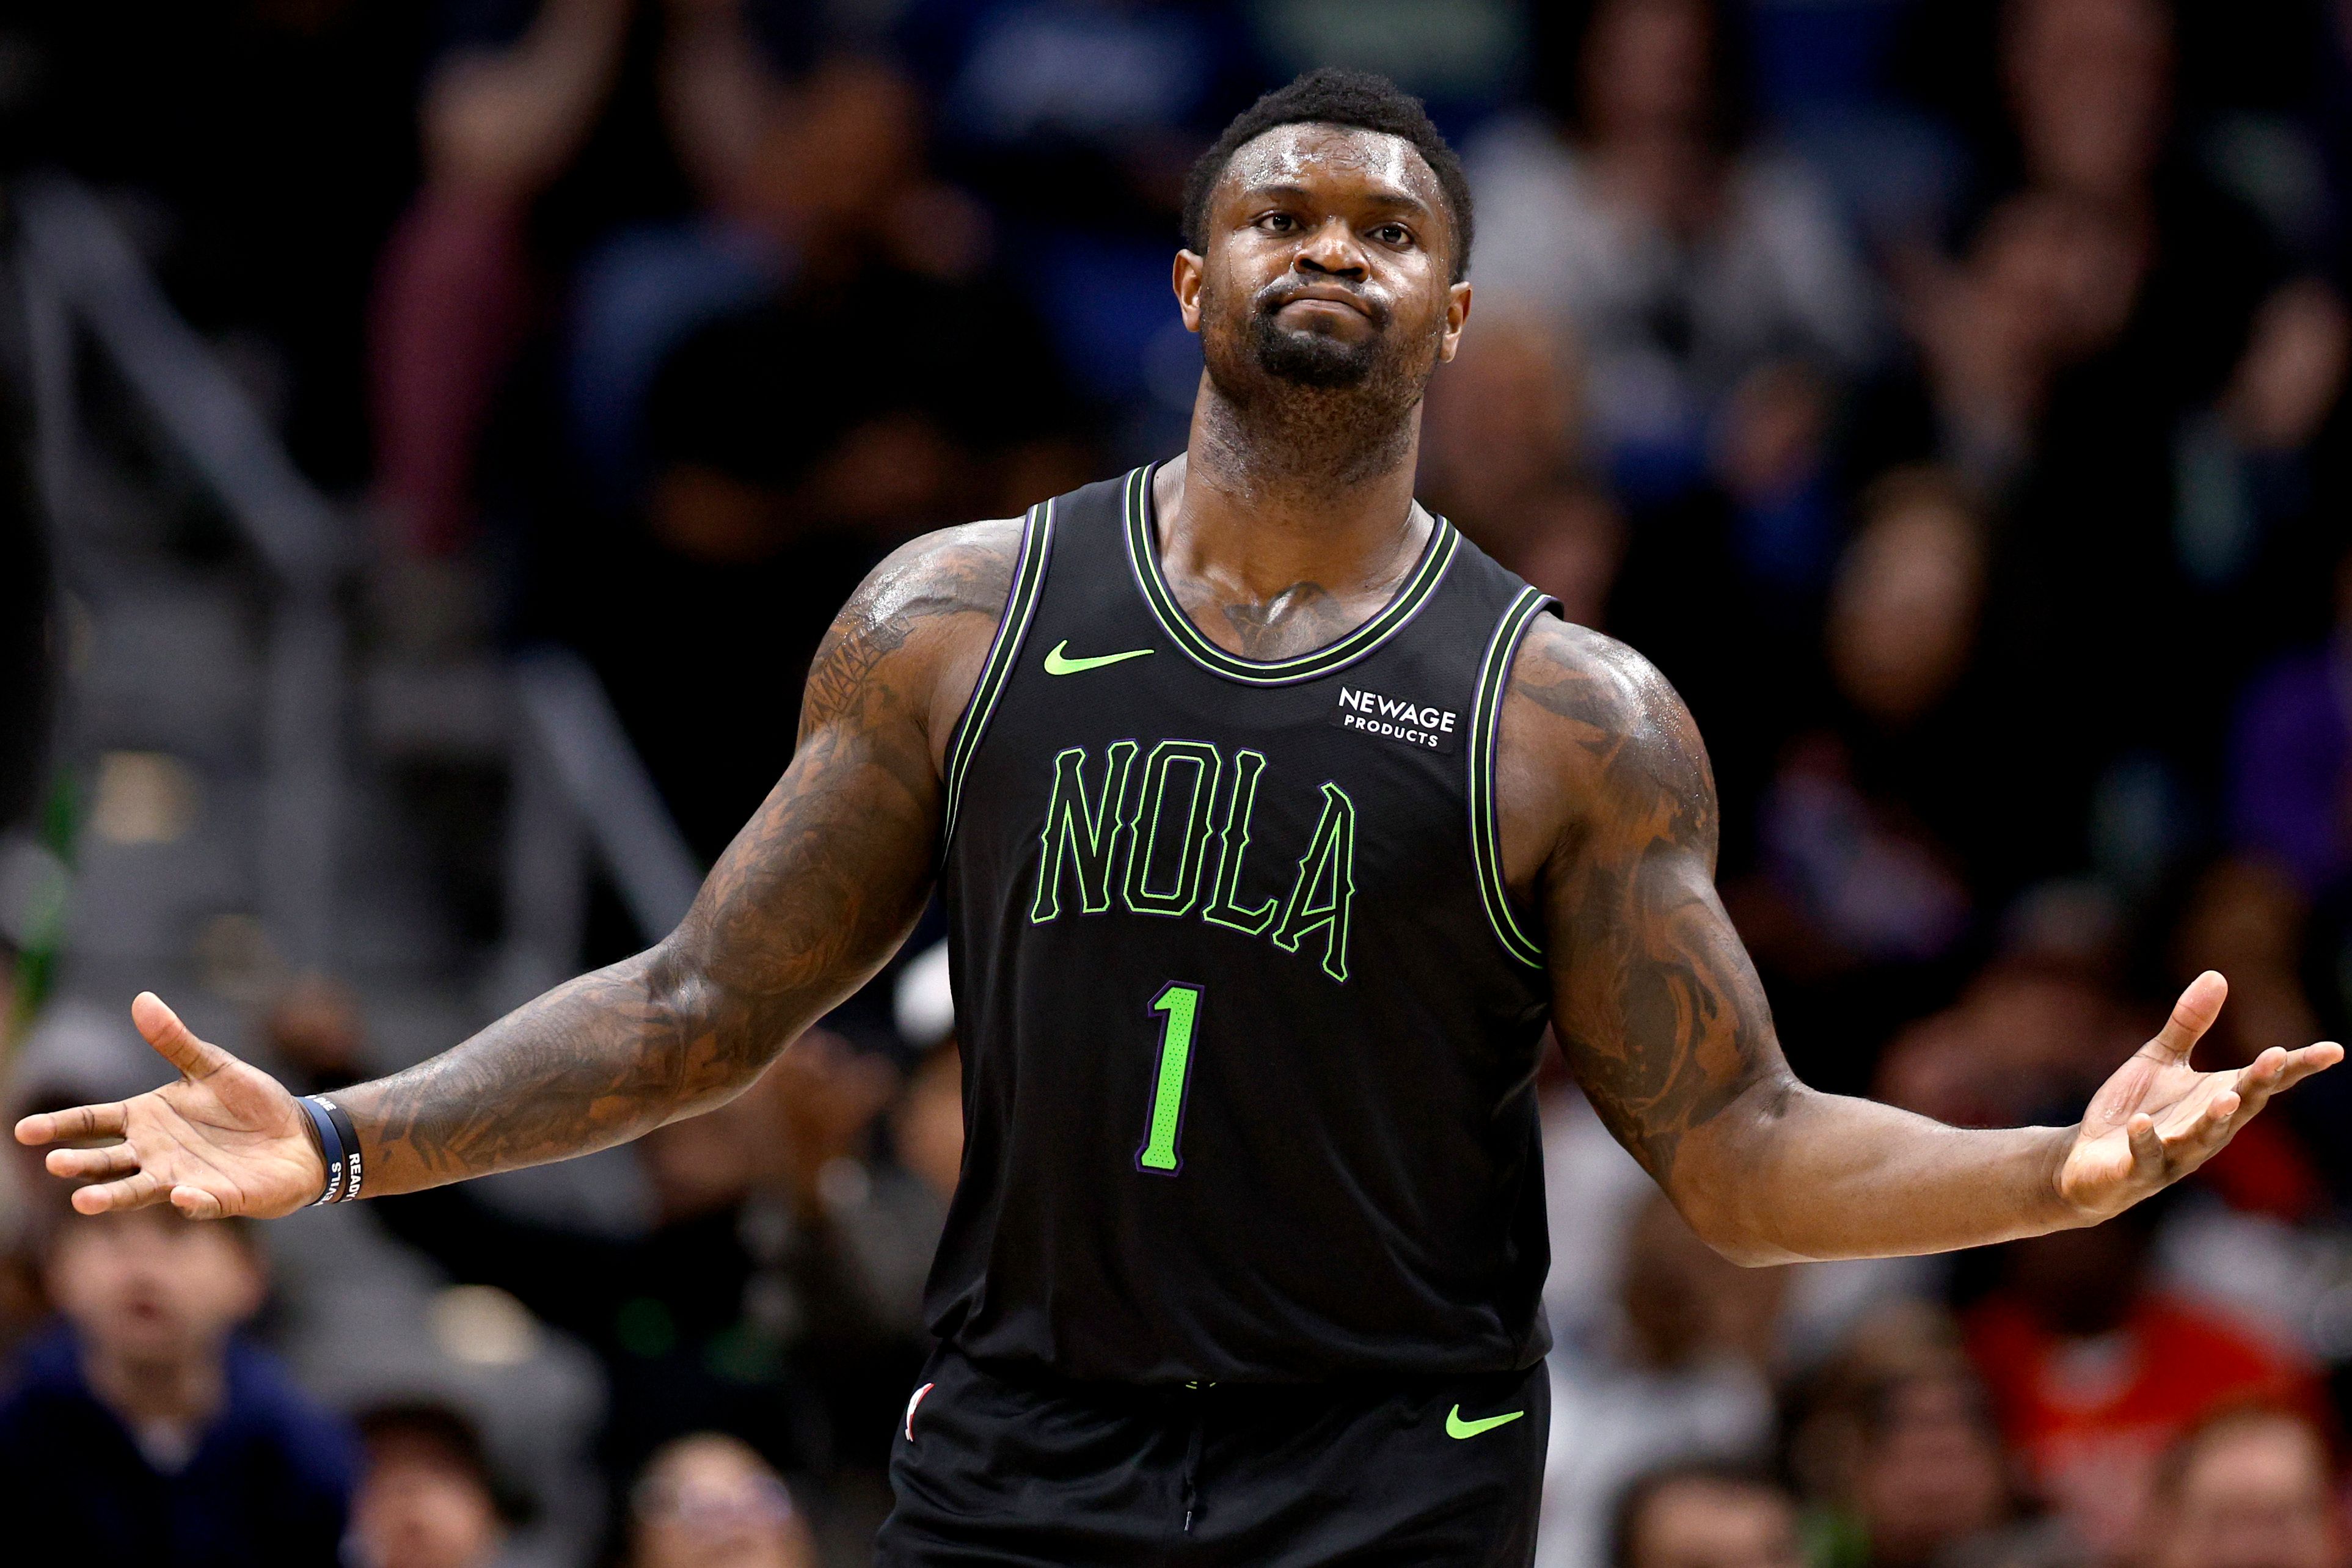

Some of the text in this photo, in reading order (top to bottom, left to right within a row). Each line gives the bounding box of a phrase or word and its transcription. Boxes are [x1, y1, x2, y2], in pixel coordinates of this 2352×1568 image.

[1339, 687, 1456, 733] NEWAGE
[1344, 714, 1439, 747] PRODUCTS
[1030, 739, 1356, 983] NOLA
[1136, 981, 1203, 1175] 1
[346, 1153, 361, 1197] READY
